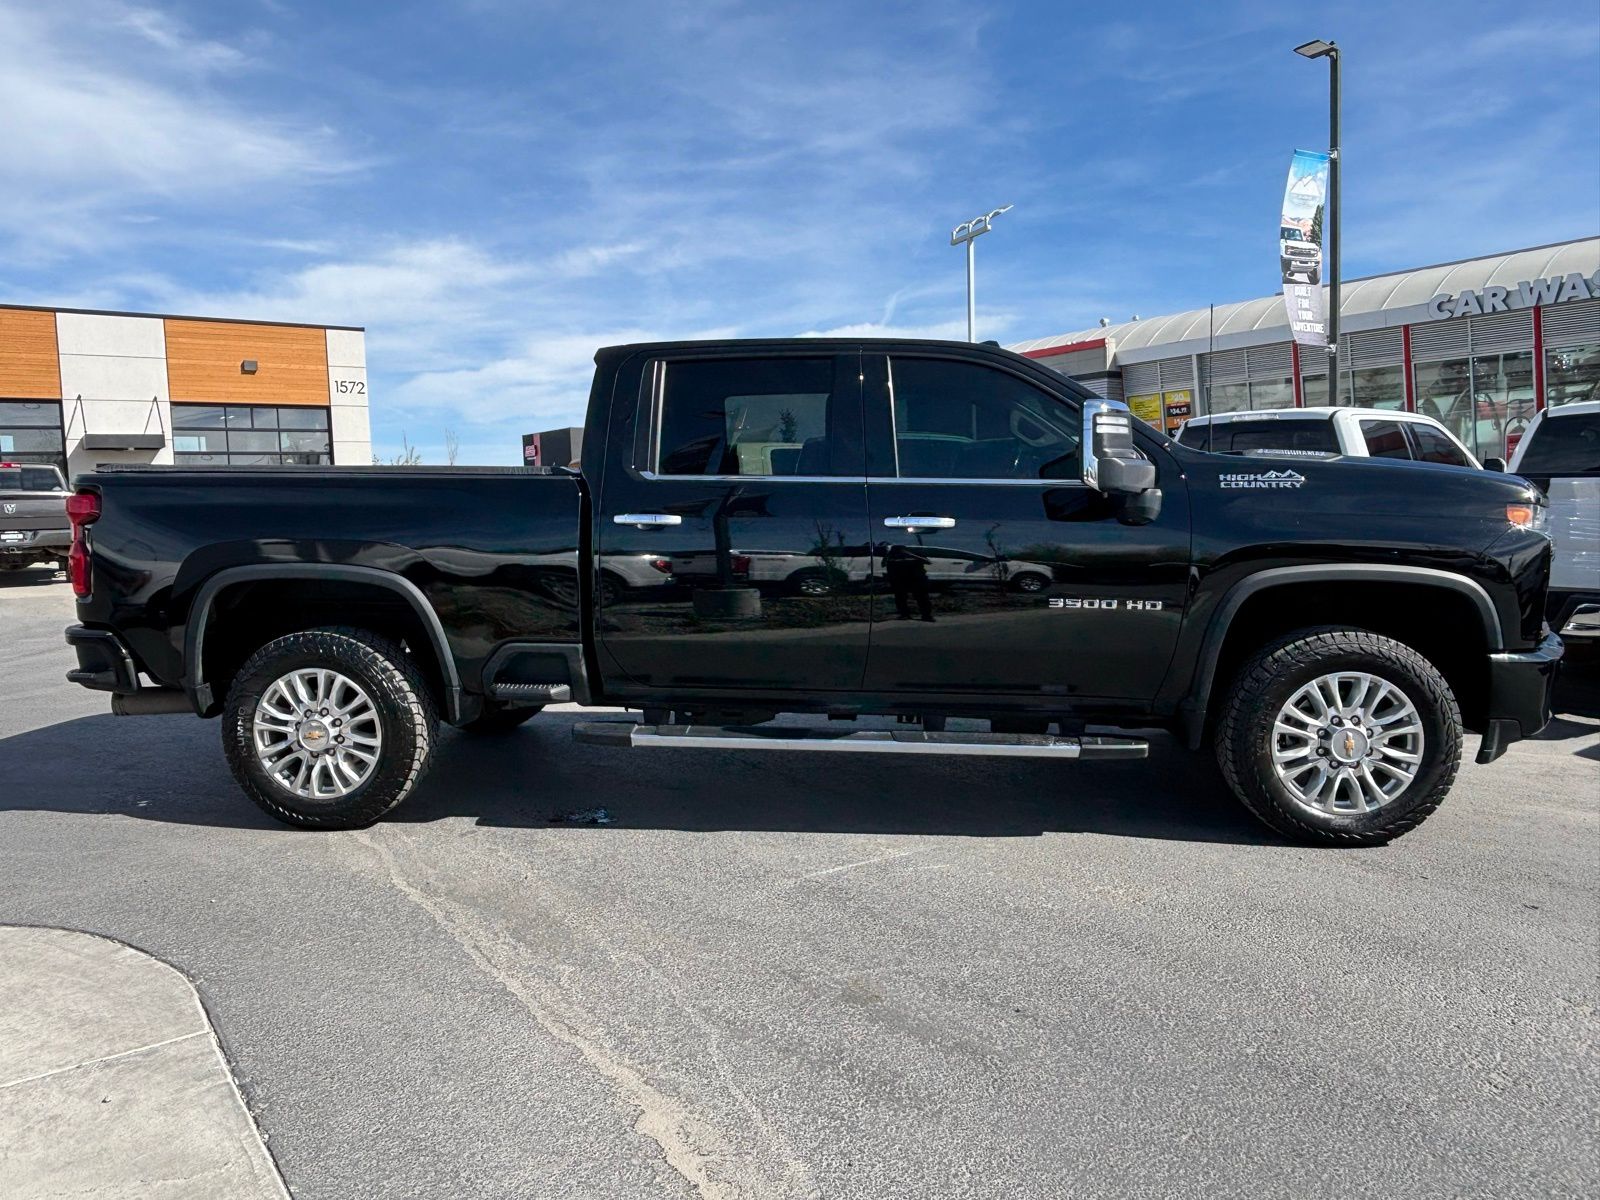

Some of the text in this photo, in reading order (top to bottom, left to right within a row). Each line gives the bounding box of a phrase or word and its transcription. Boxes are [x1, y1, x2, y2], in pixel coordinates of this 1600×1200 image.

[1429, 286, 1509, 319] CAR
[1293, 321, 1325, 334] ADVENTURE
[334, 380, 366, 395] 1572
[1219, 473, 1263, 481] HIGH
[1220, 481, 1304, 489] COUNTRY
[1048, 598, 1162, 611] 3500 HD
